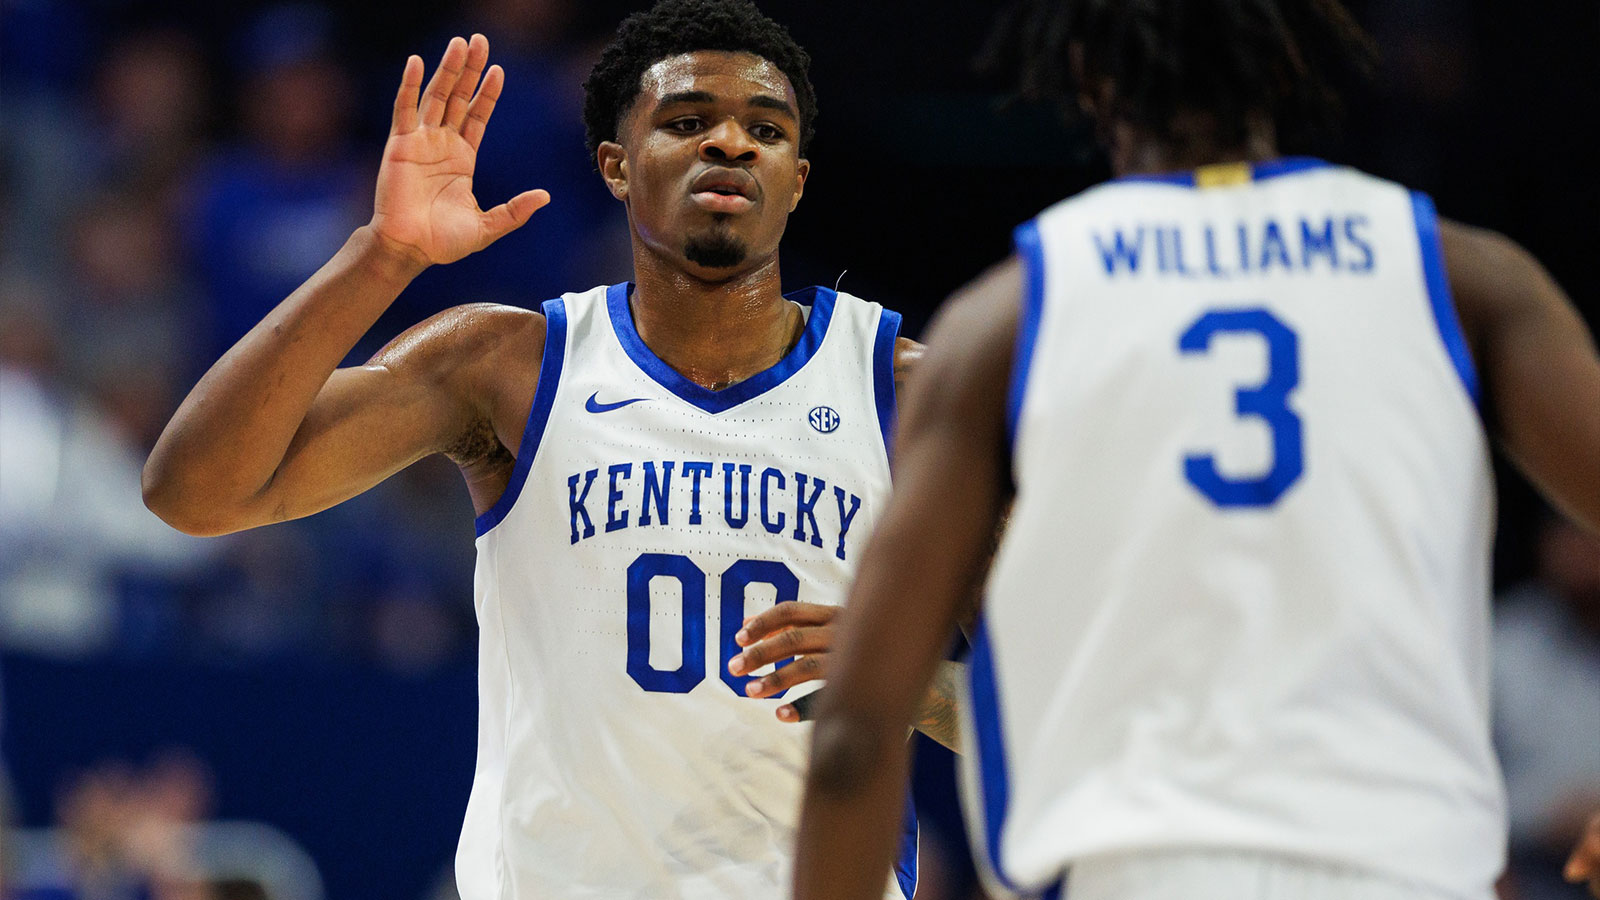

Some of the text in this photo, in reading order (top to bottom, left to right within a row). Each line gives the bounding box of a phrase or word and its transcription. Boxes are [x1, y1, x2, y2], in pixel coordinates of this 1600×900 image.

[1092, 214, 1376, 278] WILLIAMS
[810, 407, 839, 432] SEC
[1177, 307, 1305, 509] 3
[567, 461, 861, 561] KENTUCKY
[626, 553, 800, 699] 00
